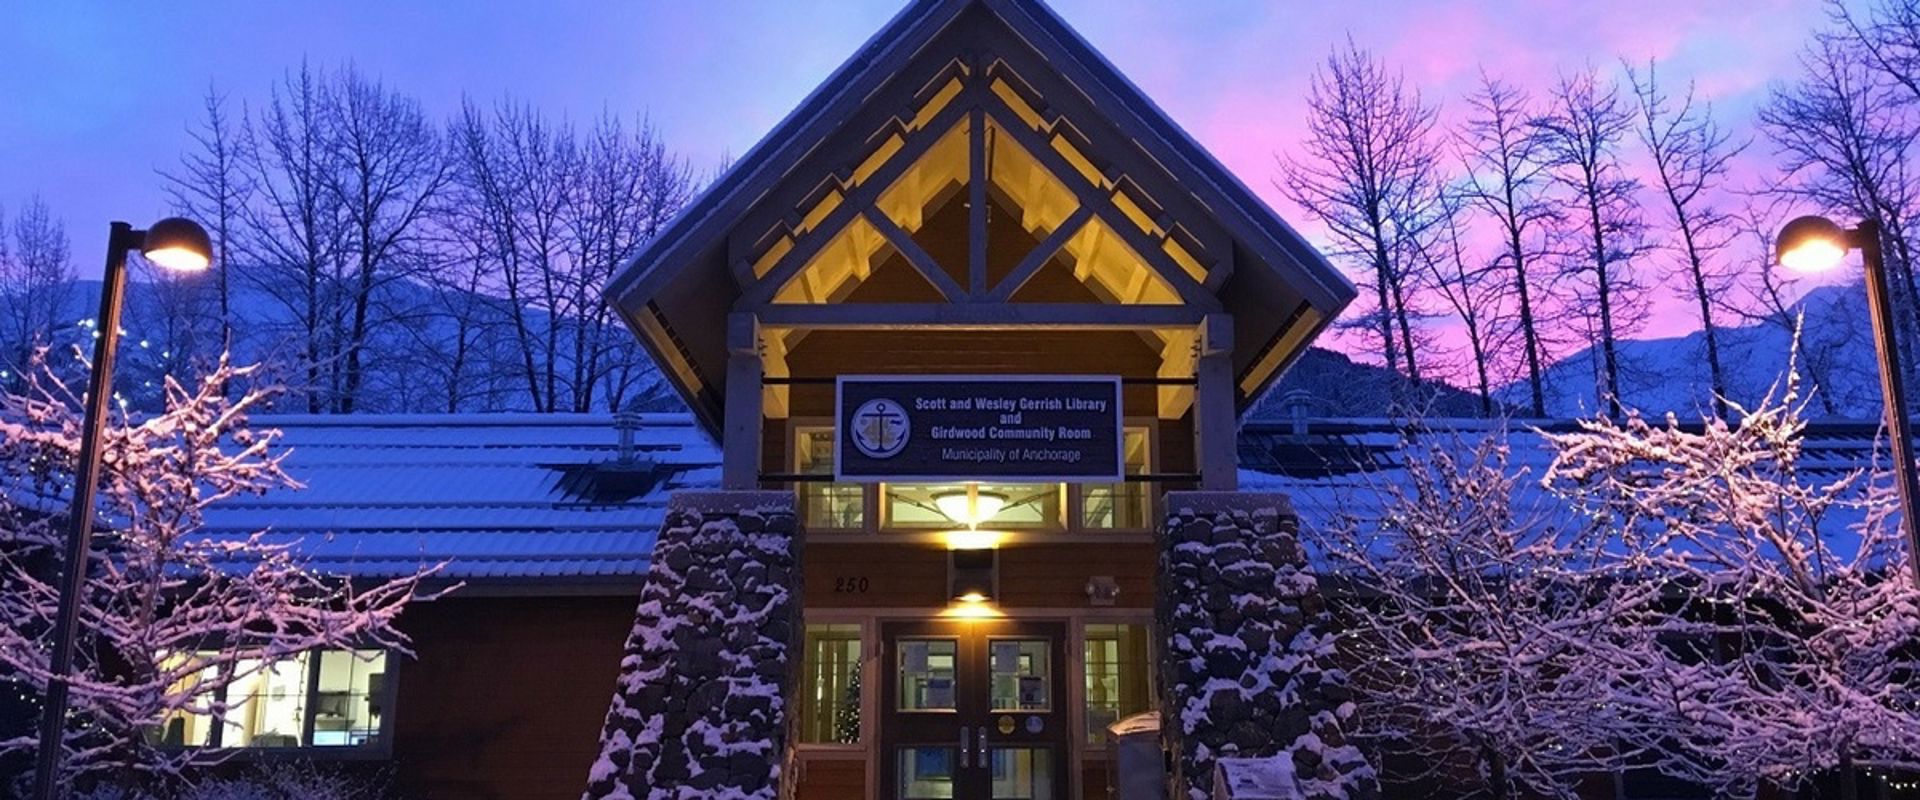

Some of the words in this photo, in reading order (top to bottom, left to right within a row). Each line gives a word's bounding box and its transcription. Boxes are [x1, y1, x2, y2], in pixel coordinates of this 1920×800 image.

[915, 398, 946, 410] Scott
[950, 398, 971, 410] and
[975, 398, 1016, 412] Wesley
[1019, 398, 1062, 410] Gerrish
[1066, 398, 1107, 412] Library
[1000, 412, 1022, 424] and
[931, 426, 986, 439] Girdwood
[989, 427, 1055, 441] Community
[1058, 427, 1092, 439] Room
[942, 448, 1005, 463] Municipality
[1009, 448, 1020, 460] of
[1022, 448, 1081, 463] Anchorage
[835, 576, 869, 593] 250
